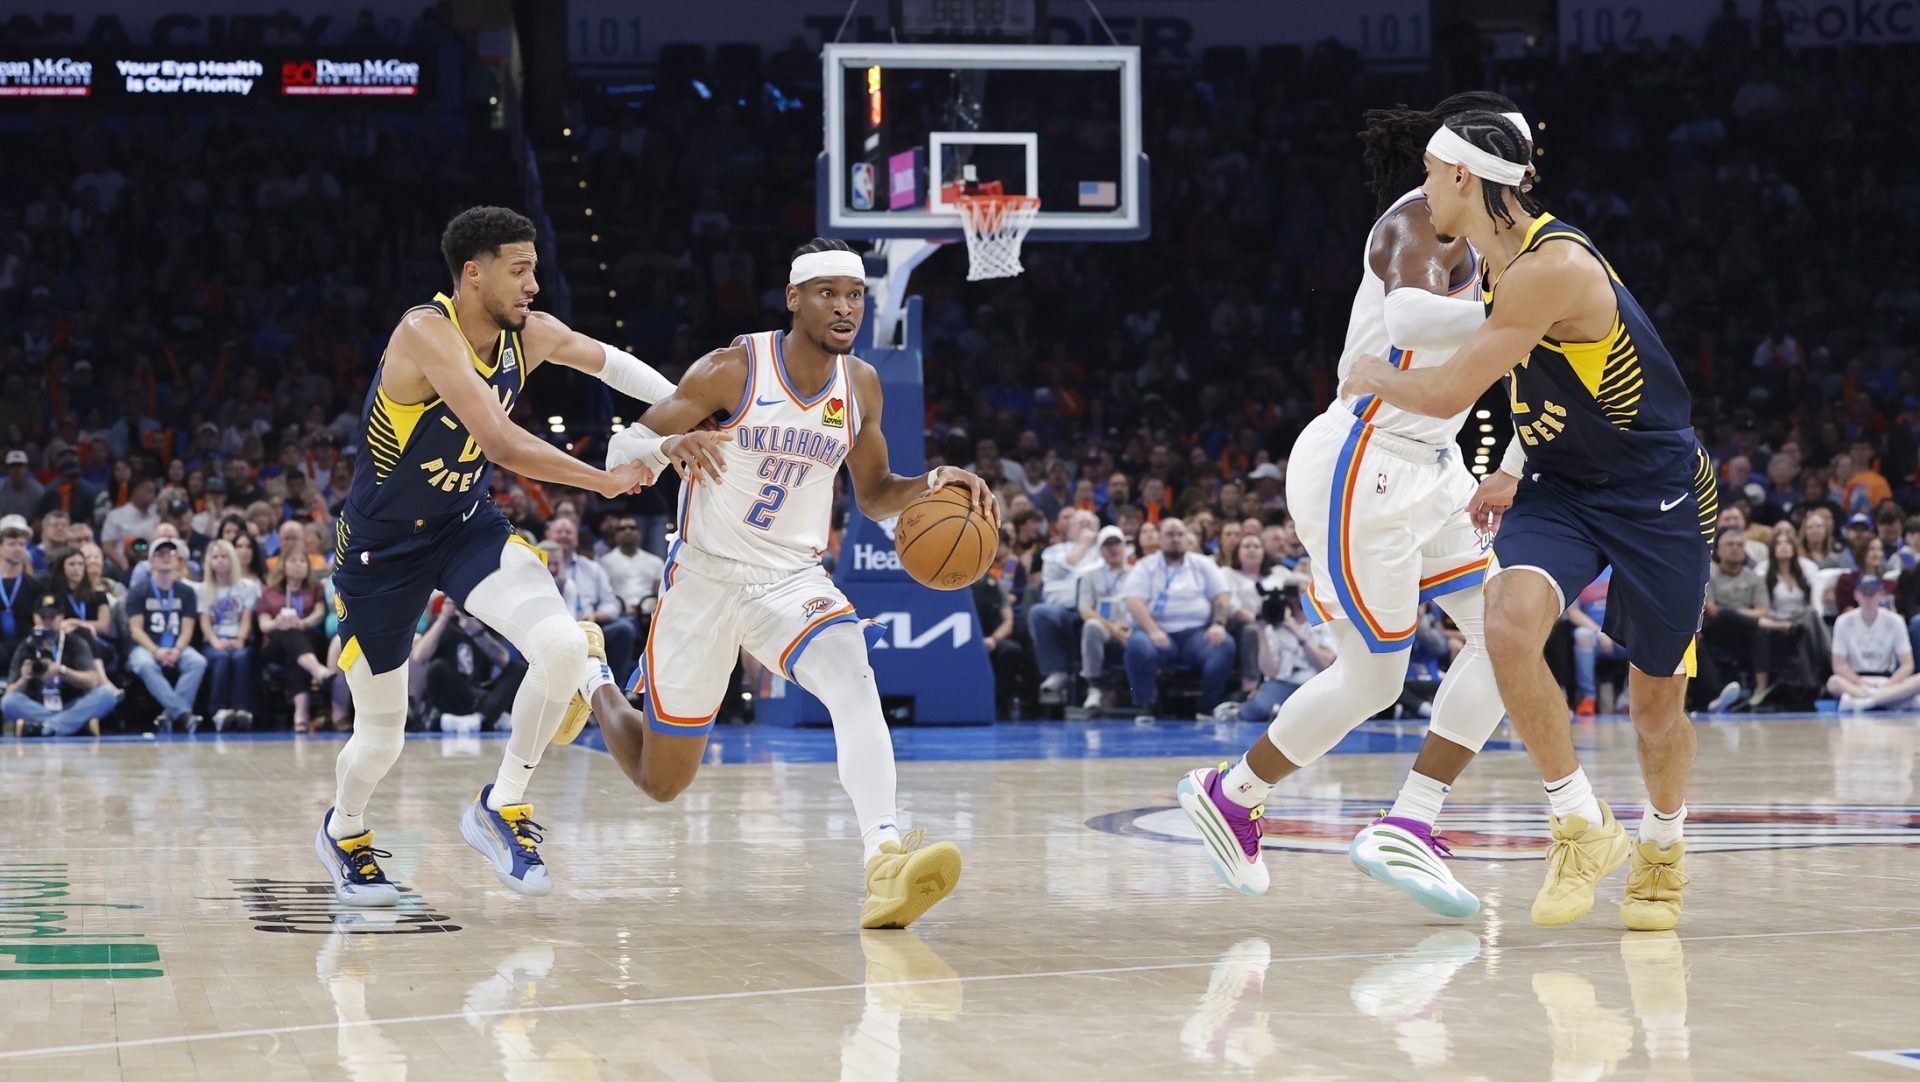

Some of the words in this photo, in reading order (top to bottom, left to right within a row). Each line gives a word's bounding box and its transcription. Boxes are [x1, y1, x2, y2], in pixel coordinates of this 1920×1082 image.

[578, 18, 642, 56] 101
[1356, 14, 1423, 53] 101
[1571, 7, 1642, 46] 102
[0, 61, 30, 76] ean
[116, 60, 160, 76] Your
[161, 60, 198, 78] Eye
[200, 60, 263, 76] Health
[283, 63, 316, 85] 50
[316, 59, 362, 77] Dean
[364, 59, 419, 77] McGee
[126, 76, 144, 92] Is
[145, 77, 181, 92] Our
[182, 77, 253, 95] Priority
[823, 415, 843, 426] Love's
[737, 425, 847, 469] OKLAHOMA
[757, 456, 812, 488] CITY
[743, 483, 788, 531] 2
